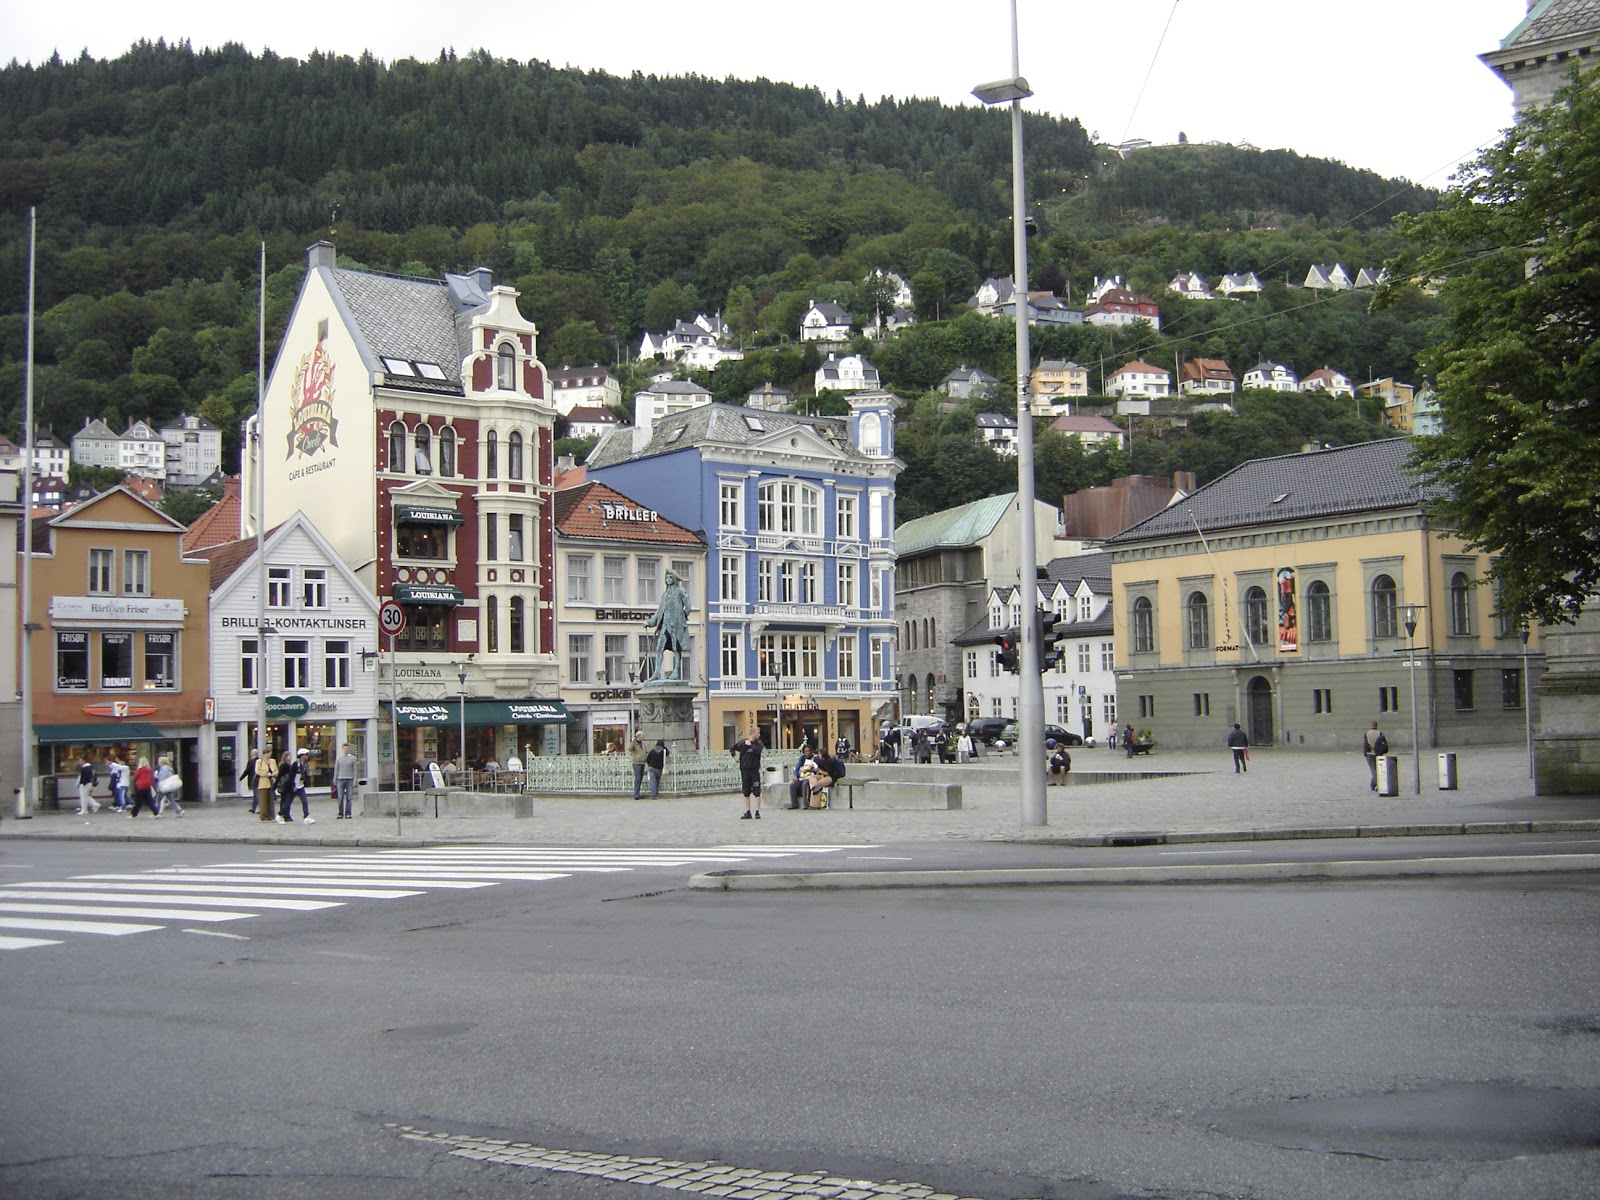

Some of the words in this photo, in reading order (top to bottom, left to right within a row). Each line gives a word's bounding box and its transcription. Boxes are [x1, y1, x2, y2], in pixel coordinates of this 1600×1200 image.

[289, 469, 300, 481] CAFE
[306, 458, 336, 477] RESTAURANT
[410, 511, 454, 521] LOUISIANA
[606, 509, 658, 522] BRILLER
[410, 591, 455, 600] LOUISIANA
[384, 609, 401, 625] 30
[61, 633, 85, 643] FRISØR
[148, 634, 172, 643] FRISØR
[395, 669, 442, 678] LOUISIANA
[264, 703, 304, 711] Specsavers
[310, 702, 338, 712] Optikk
[396, 706, 449, 714] LOUISIANA
[508, 705, 558, 713] LOUISIANA
[766, 700, 819, 711] macumba
